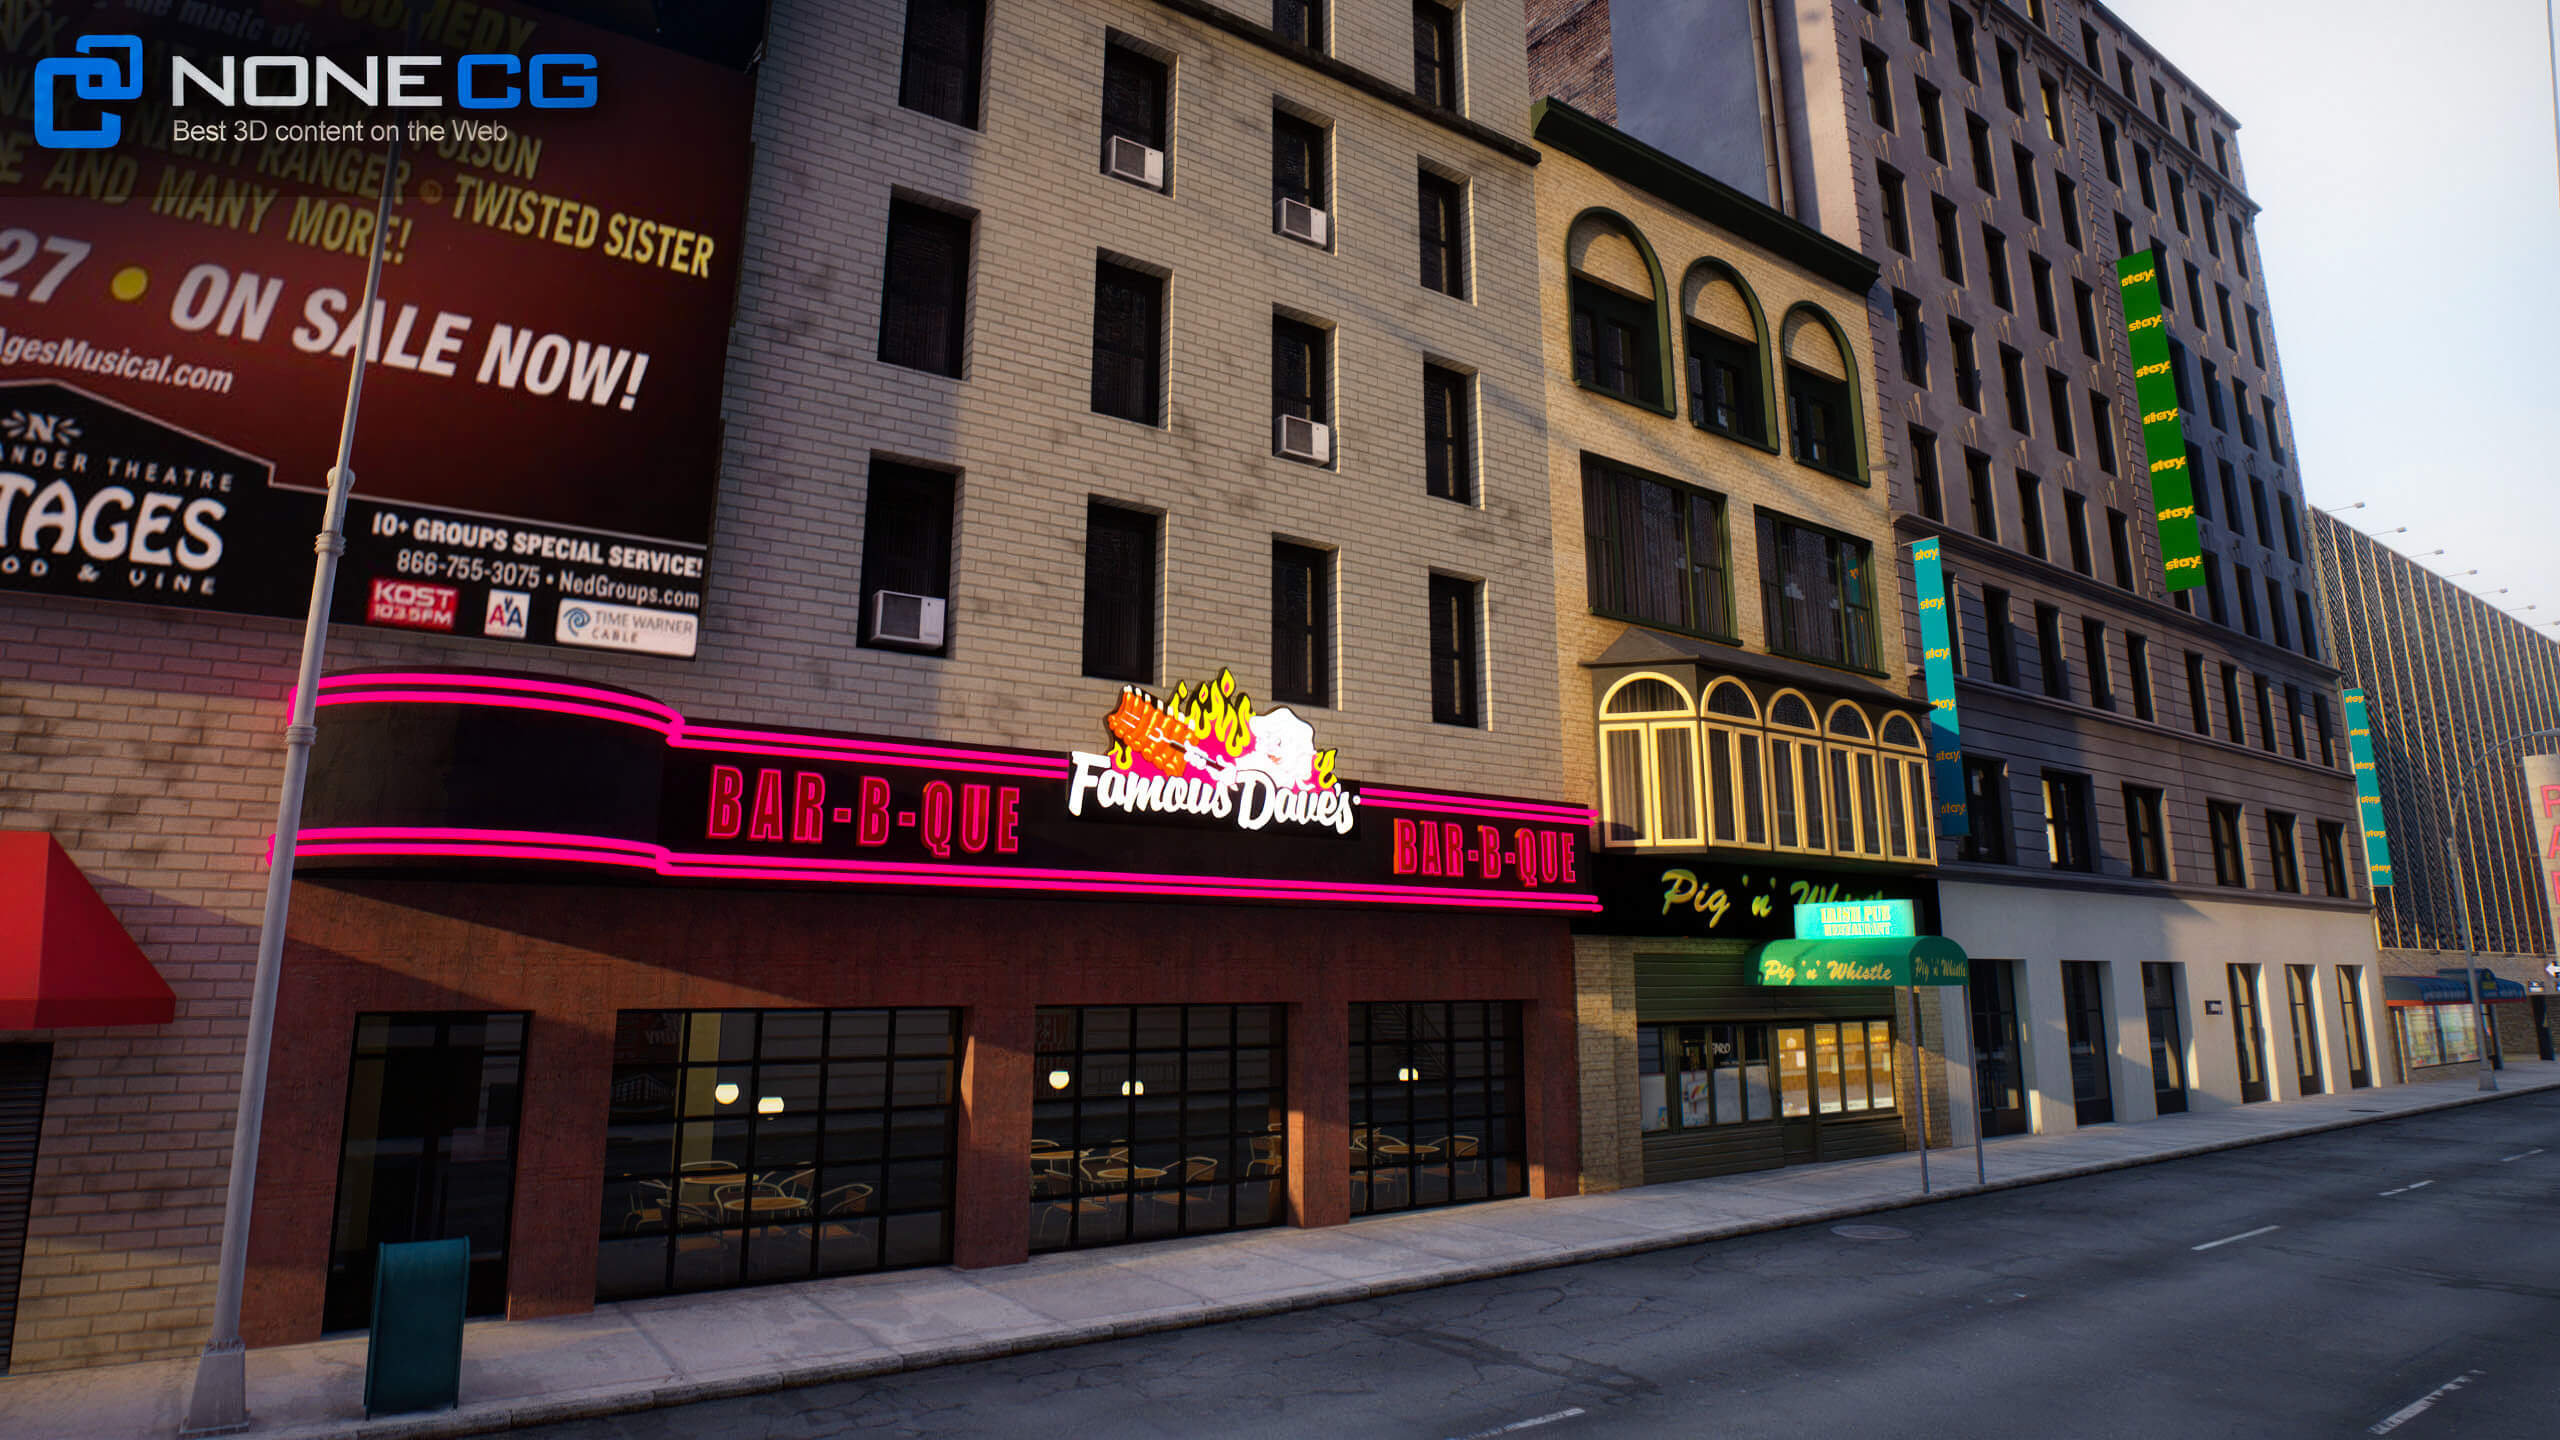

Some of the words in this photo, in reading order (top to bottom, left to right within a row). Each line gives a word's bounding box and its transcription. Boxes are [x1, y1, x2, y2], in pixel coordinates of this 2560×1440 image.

[42, 150, 139, 206] AND
[151, 164, 278, 235] MANY
[453, 173, 600, 250] TWISTED
[603, 212, 715, 279] SISTER
[0, 228, 92, 304] 27
[170, 263, 285, 343] ON
[292, 287, 473, 378] SALE
[476, 323, 650, 412] NOW!
[0, 326, 234, 394] gesMusical.com
[107, 457, 235, 492] THEATRE
[371, 511, 409, 537] 10+
[413, 517, 509, 551] GROUPS
[513, 531, 605, 565] SPECIAL
[609, 545, 704, 578] SERVICE!
[129, 567, 217, 596] VINE
[374, 580, 455, 609] KOST
[396, 549, 541, 589] 866-755-3075
[558, 569, 700, 609] NedGroups.com
[592, 627, 639, 644] CABLE
[594, 610, 629, 628] TIME
[632, 615, 694, 635] WARNER
[705, 763, 1021, 860] BAR-B-QUE
[1068, 750, 1234, 817] Famous
[1234, 768, 1354, 836] Dave's
[1393, 817, 1577, 889] BAR-B-QUE
[1660, 868, 1731, 929] Pig
[1763, 959, 1798, 986] Pig
[1827, 959, 1893, 981] Whistle
